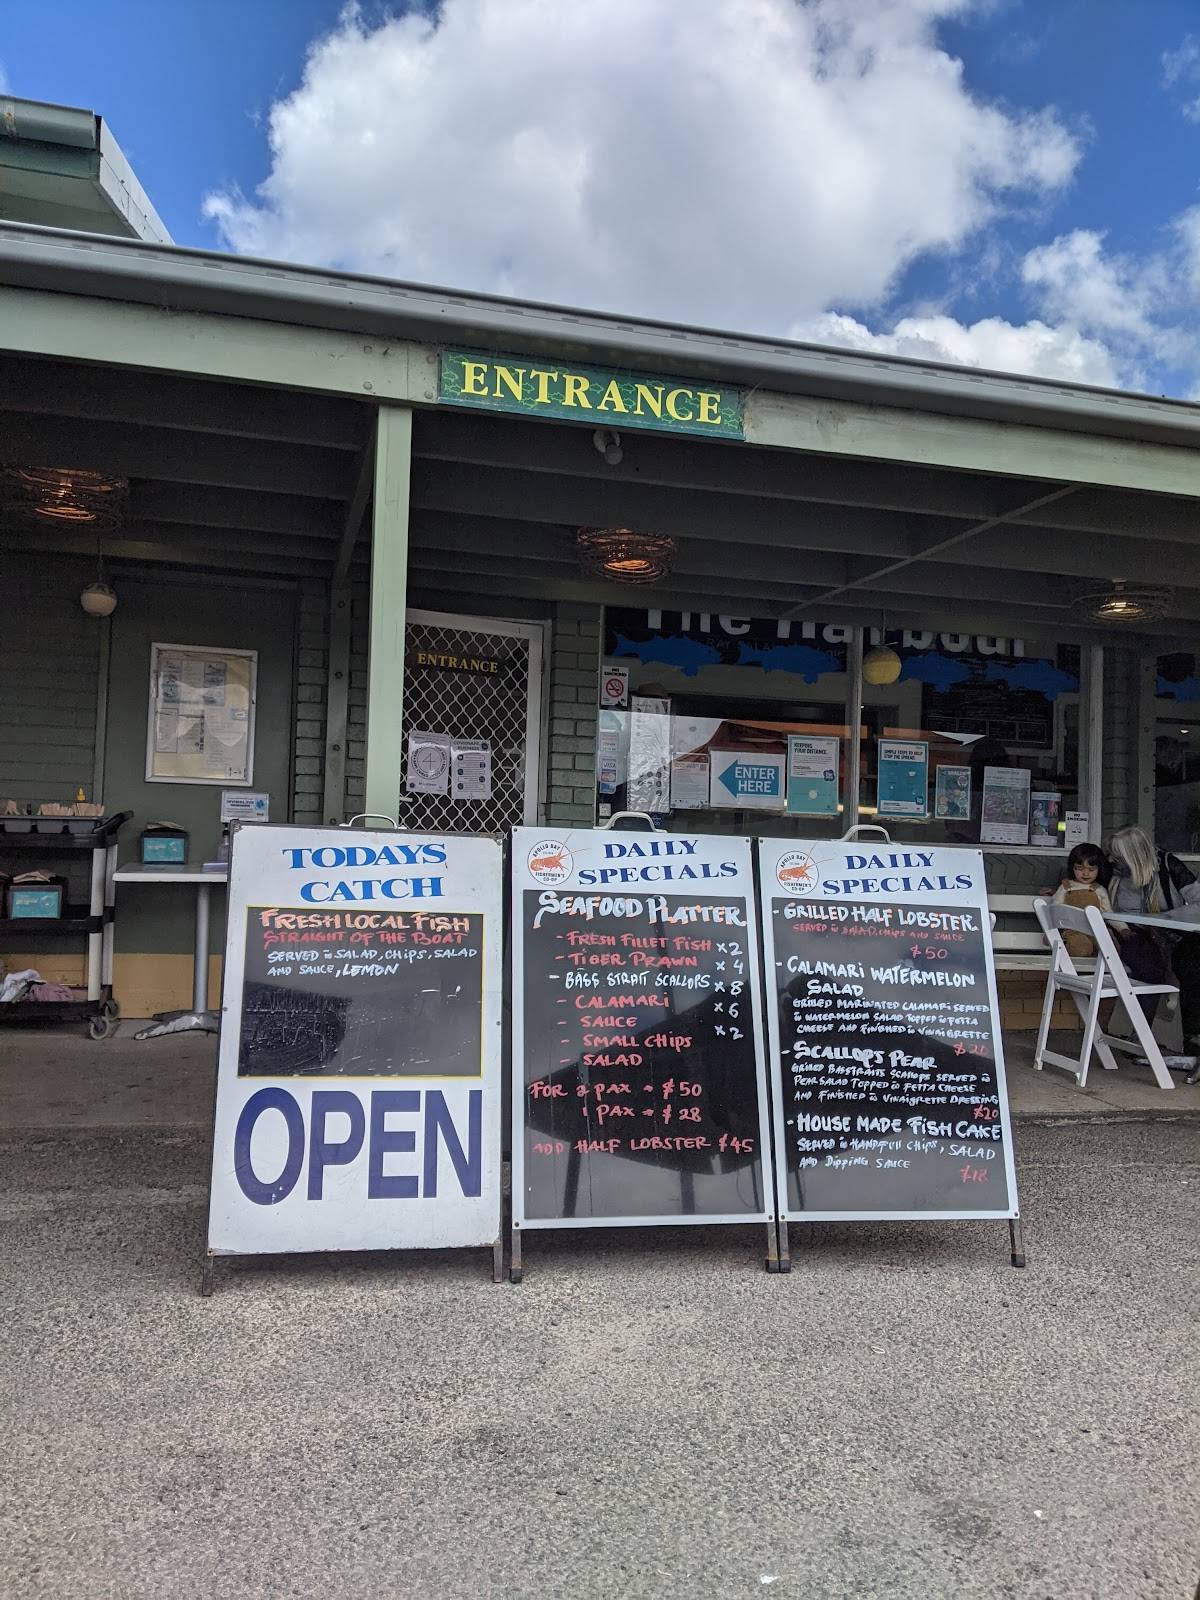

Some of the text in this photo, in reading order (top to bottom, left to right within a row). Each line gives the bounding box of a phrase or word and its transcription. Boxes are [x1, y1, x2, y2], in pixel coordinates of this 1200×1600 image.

[461, 361, 722, 425] ENTRANCE
[417, 653, 498, 673] ENTRANCE
[735, 767, 775, 780] ENTER
[738, 780, 772, 793] HERE
[282, 843, 447, 869] TODAYS
[532, 843, 549, 858] APOLLO
[604, 840, 699, 859] DAILY
[844, 853, 934, 870] DAILY
[578, 862, 738, 885] SPECIALS
[300, 876, 446, 903] CATCH
[822, 875, 973, 895] SPECIALS
[533, 891, 747, 929] SEAFOOD PLATTER
[784, 902, 849, 922] GRILLED
[851, 905, 893, 927] HALF
[259, 908, 341, 930] FRESH
[344, 913, 411, 929] LOCAL
[350, 932, 374, 946] OF
[376, 931, 406, 944] THE
[411, 932, 468, 946] BOAT
[566, 931, 616, 946] FRESH
[267, 950, 320, 964] SERVED
[434, 948, 477, 959] SALAD
[629, 951, 698, 968] PRAWN
[267, 966, 292, 976] AND
[342, 963, 400, 977] LEMON
[871, 965, 976, 988] WATERMELON
[565, 971, 600, 989] BASS
[655, 974, 711, 989] SCALLOPS
[807, 979, 865, 997] SALAD
[953, 1004, 991, 1013] SERVED
[580, 1016, 638, 1028] SAUCE
[873, 1012, 904, 1021] SALAD
[906, 1013, 937, 1024] TOPPED
[838, 1023, 857, 1032] AND
[583, 1034, 640, 1048] SMALL
[583, 1054, 643, 1066] SALAD
[889, 1050, 938, 1070] PEAR
[528, 1081, 568, 1098] FOR
[794, 1075, 818, 1086] PEAR
[819, 1076, 849, 1086] SALAD
[850, 1078, 889, 1091] TOPPED
[903, 1082, 936, 1092] FETTA
[794, 1090, 812, 1101] AND
[797, 1113, 851, 1132] HOUSE
[857, 1115, 902, 1133] MADE
[955, 1121, 1002, 1140] CAKE
[234, 1087, 482, 1206] OPEN
[574, 1139, 622, 1153] HALF
[631, 1136, 712, 1150] LOBSTER
[797, 1137, 836, 1151] SERVED
[947, 1144, 996, 1160] SALAD
[799, 1157, 818, 1168] AND
[876, 1159, 911, 1169] SAUCE
